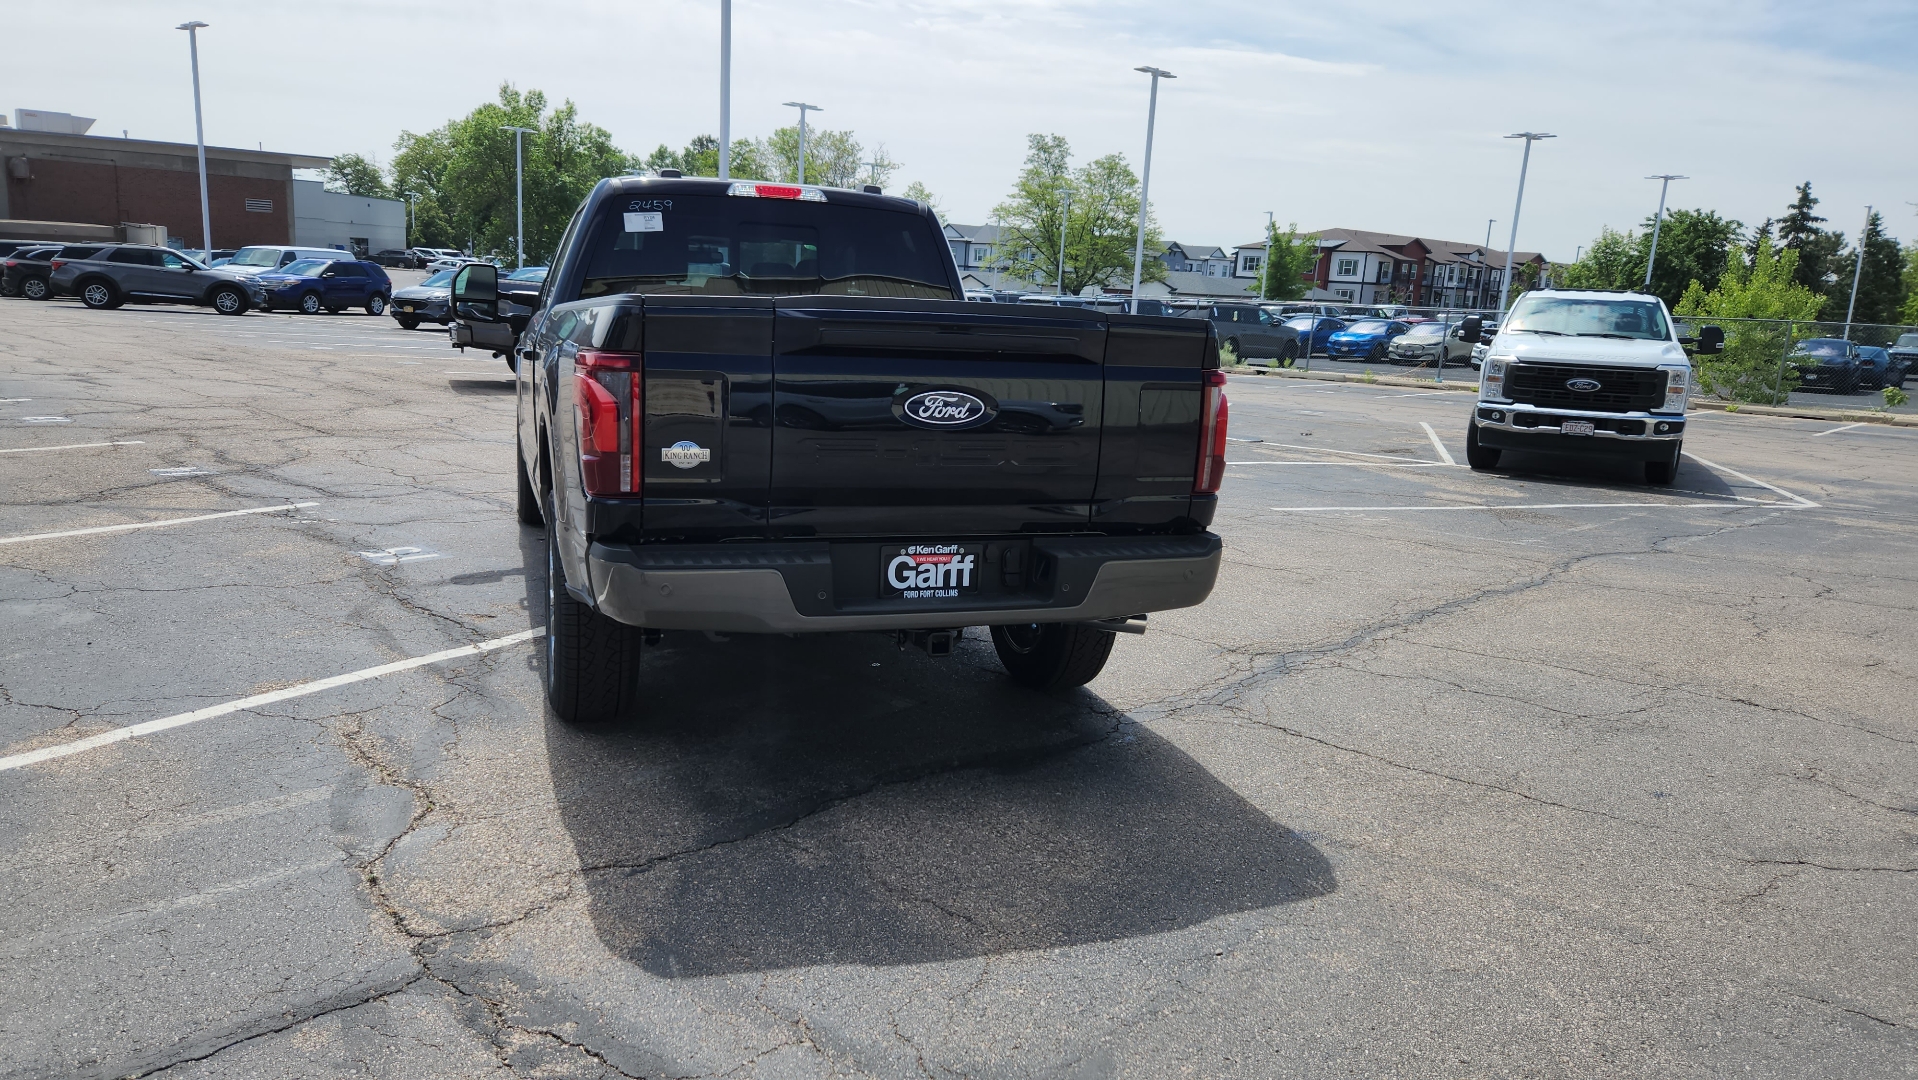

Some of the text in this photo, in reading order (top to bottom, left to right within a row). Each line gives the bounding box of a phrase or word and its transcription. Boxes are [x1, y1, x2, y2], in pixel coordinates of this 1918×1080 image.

[629, 200, 673, 211] 2459
[918, 395, 971, 418] Ford
[664, 450, 708, 460] KING RANCH
[916, 544, 958, 554] Ken Garff
[887, 554, 975, 590] Garff
[903, 589, 959, 599] FORD FORT COLLINS
